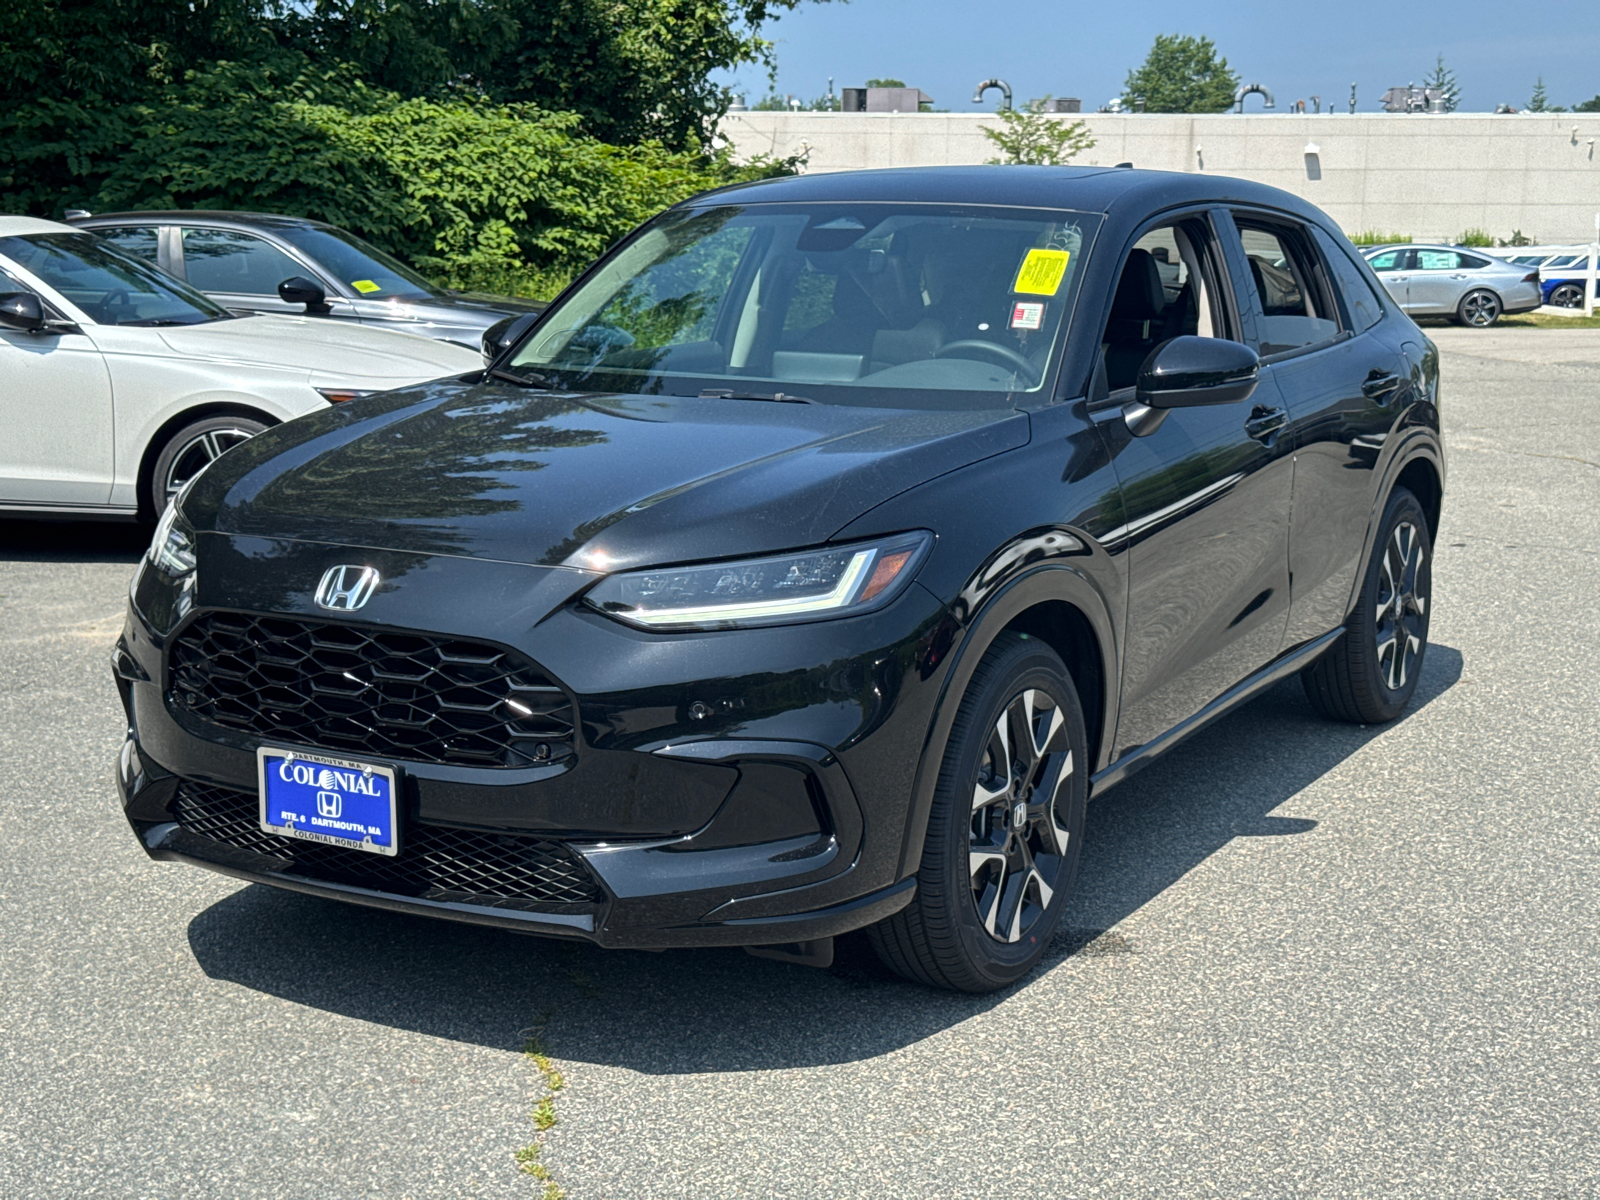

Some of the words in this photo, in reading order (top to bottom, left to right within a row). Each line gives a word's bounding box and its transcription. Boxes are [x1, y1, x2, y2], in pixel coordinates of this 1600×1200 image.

[279, 763, 381, 797] COLONIAL
[281, 811, 299, 822] RTE.
[300, 815, 306, 823] 6
[311, 817, 367, 835] DARTMOUTH,
[368, 825, 382, 836] MA
[294, 830, 333, 844] COLONIAL
[335, 838, 364, 850] HONDA
